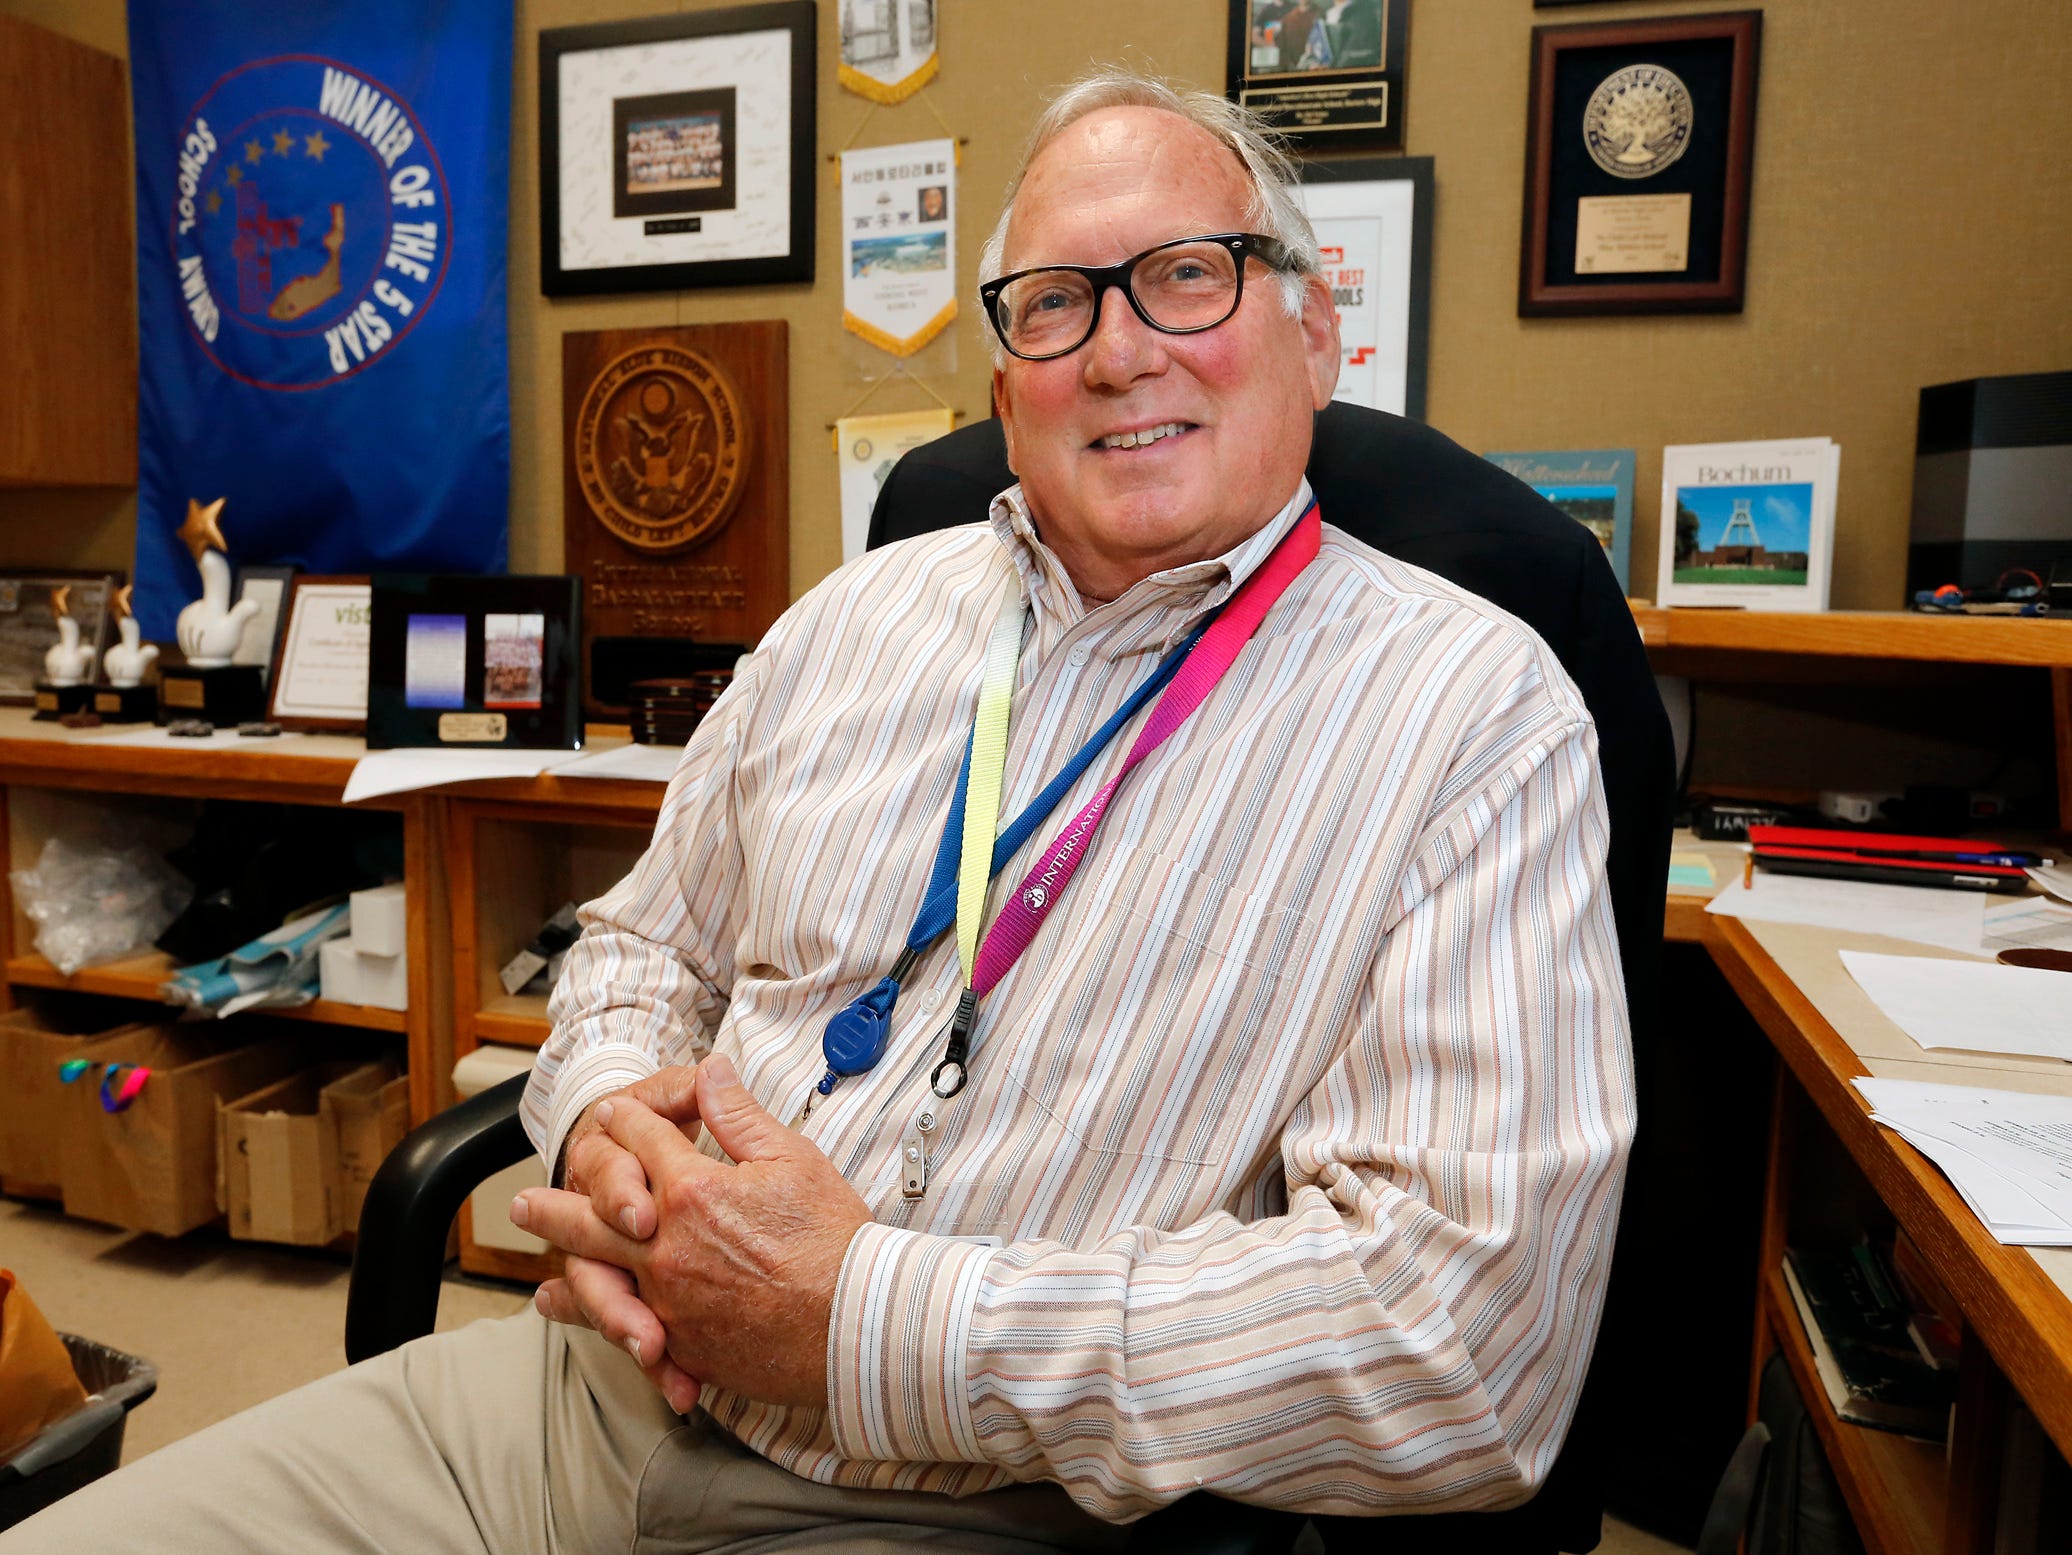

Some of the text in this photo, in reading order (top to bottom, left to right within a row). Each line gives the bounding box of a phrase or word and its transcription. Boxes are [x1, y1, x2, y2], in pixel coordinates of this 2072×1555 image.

[178, 117, 218, 235] SCHOOL
[320, 67, 438, 374] WINNER OF THE 5 STAR
[1333, 288, 1364, 306] OOLS
[1339, 269, 1364, 286] BEST
[1698, 463, 1792, 484] Bochum
[1040, 780, 1116, 887] INTERNATION
